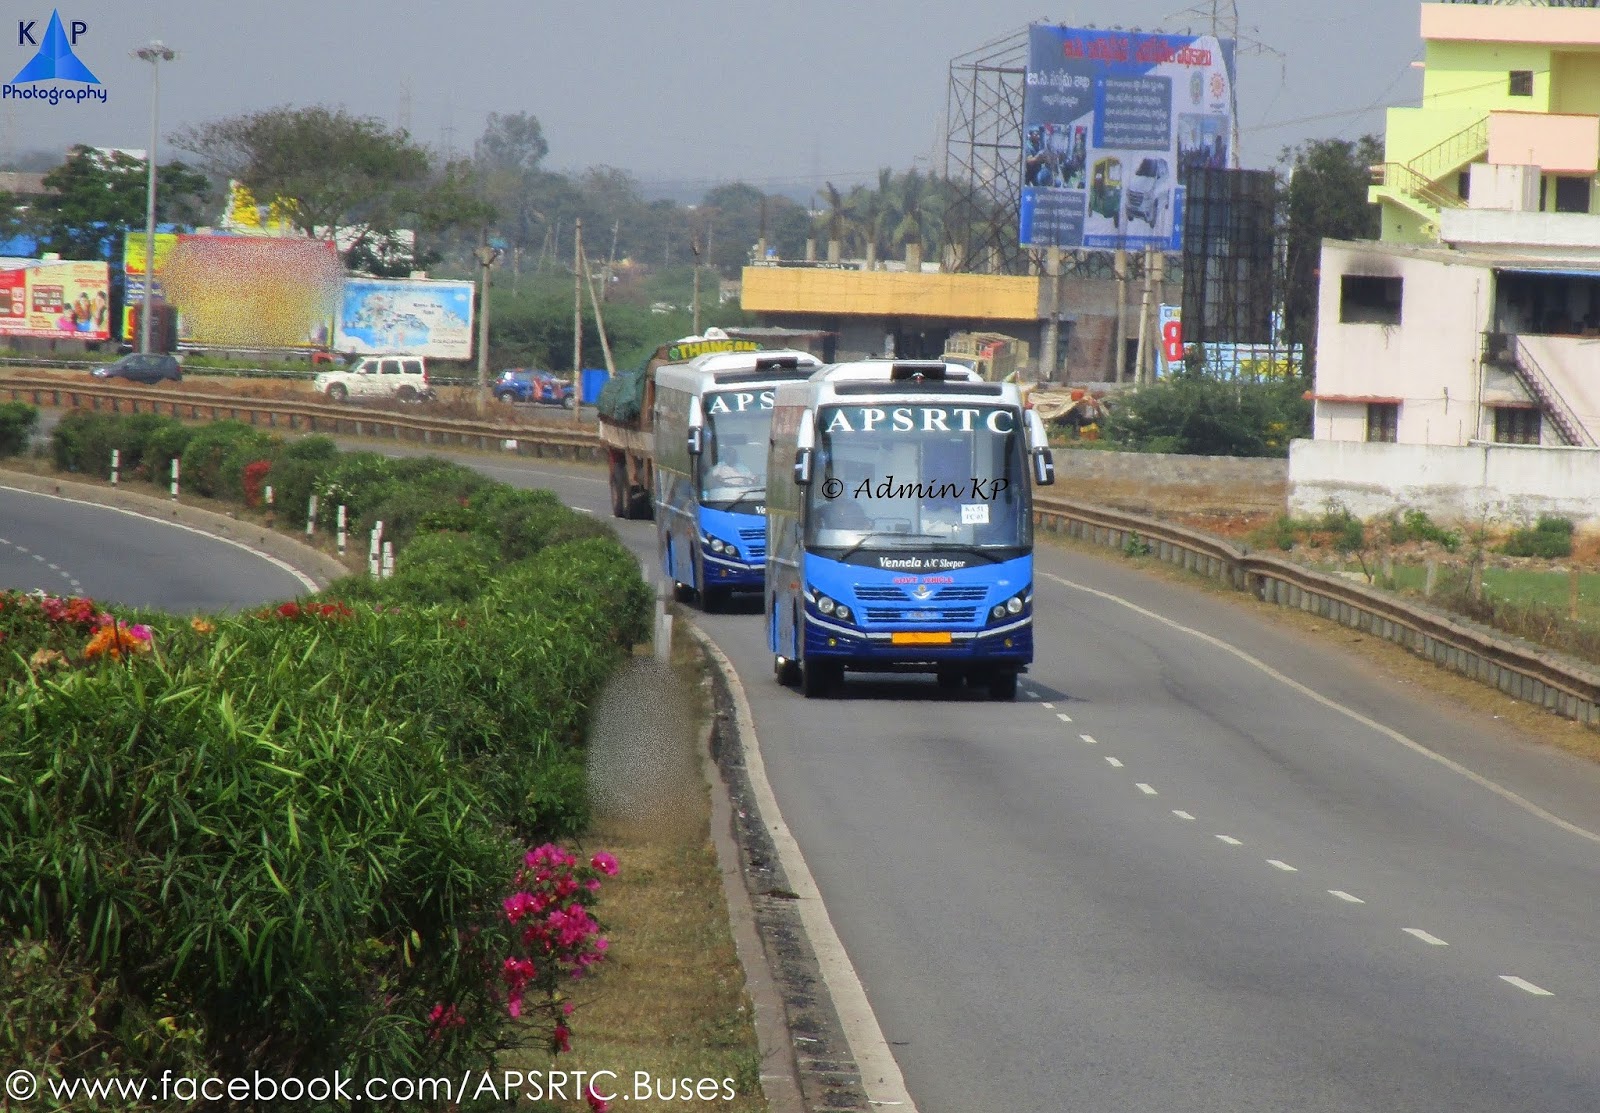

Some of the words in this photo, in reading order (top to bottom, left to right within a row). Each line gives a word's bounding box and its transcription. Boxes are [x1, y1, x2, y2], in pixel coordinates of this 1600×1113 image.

[708, 391, 775, 415] APS
[825, 408, 1014, 434] APSRTC
[879, 557, 921, 568] Vennela
[923, 559, 939, 568] A/C
[940, 559, 966, 569] Sleeper
[922, 576, 954, 585] VEHICLE
